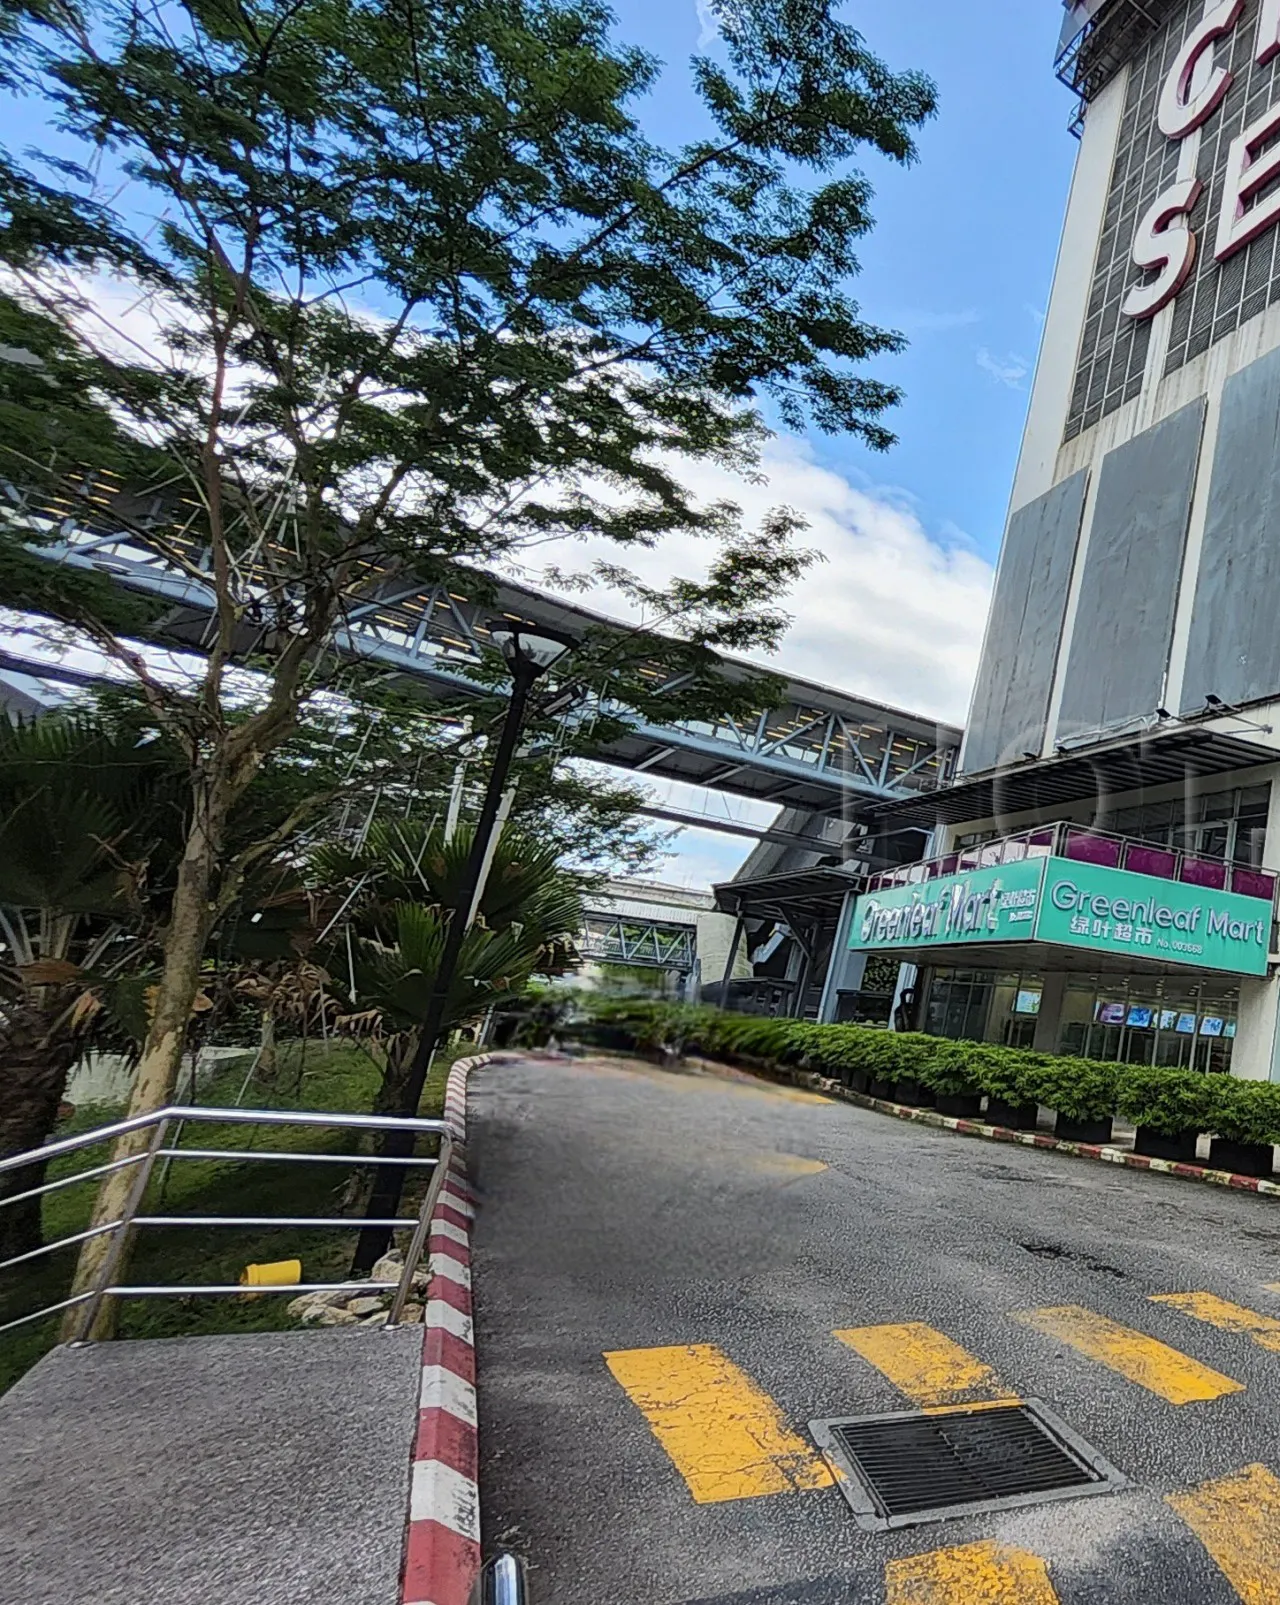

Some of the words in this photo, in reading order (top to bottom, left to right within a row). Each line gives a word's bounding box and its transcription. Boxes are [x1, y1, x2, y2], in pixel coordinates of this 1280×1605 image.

[1052, 880, 1202, 933] Greenleaf
[1206, 908, 1265, 944] Mart
[1070, 915, 1154, 945] 绿叶超市
